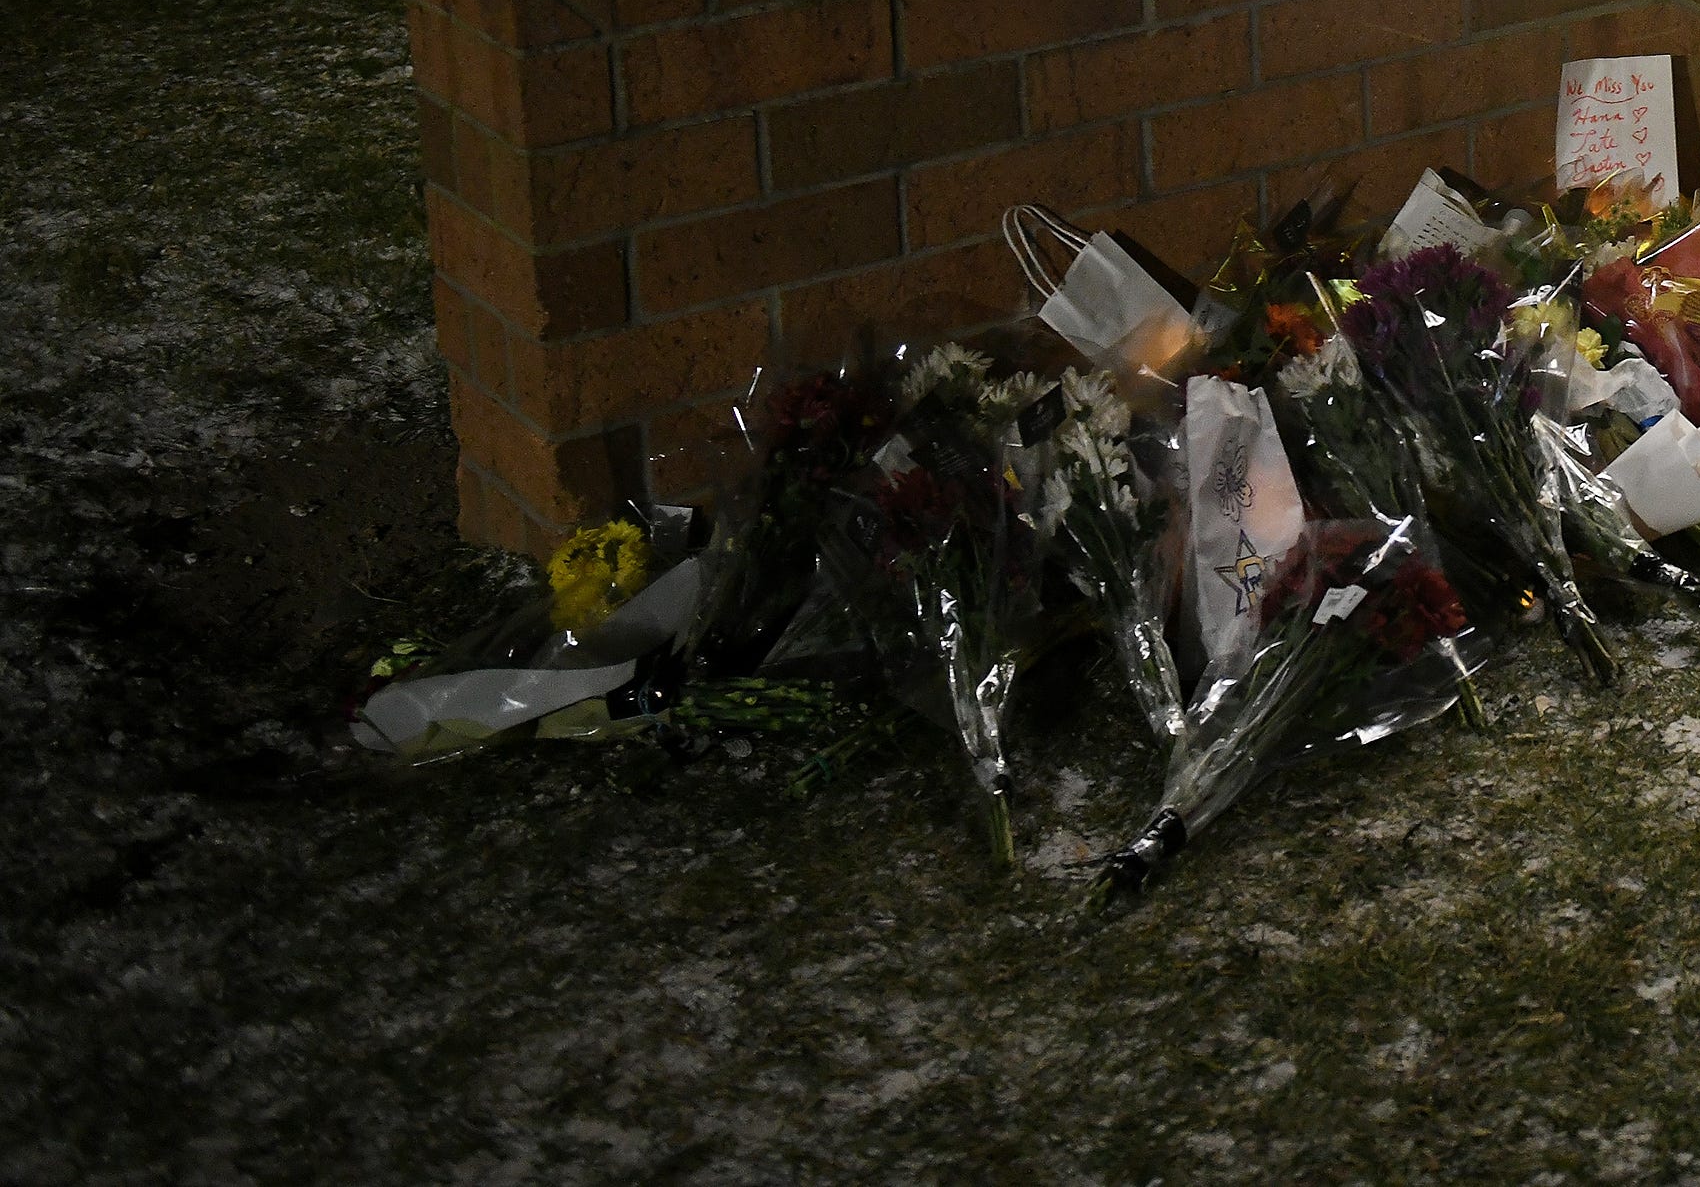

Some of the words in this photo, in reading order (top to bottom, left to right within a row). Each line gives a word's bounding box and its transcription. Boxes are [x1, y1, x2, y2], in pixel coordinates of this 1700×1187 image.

[1594, 76, 1623, 94] Miss
[1630, 74, 1654, 95] You
[1572, 106, 1625, 126] Hana
[1569, 128, 1618, 154] Tate
